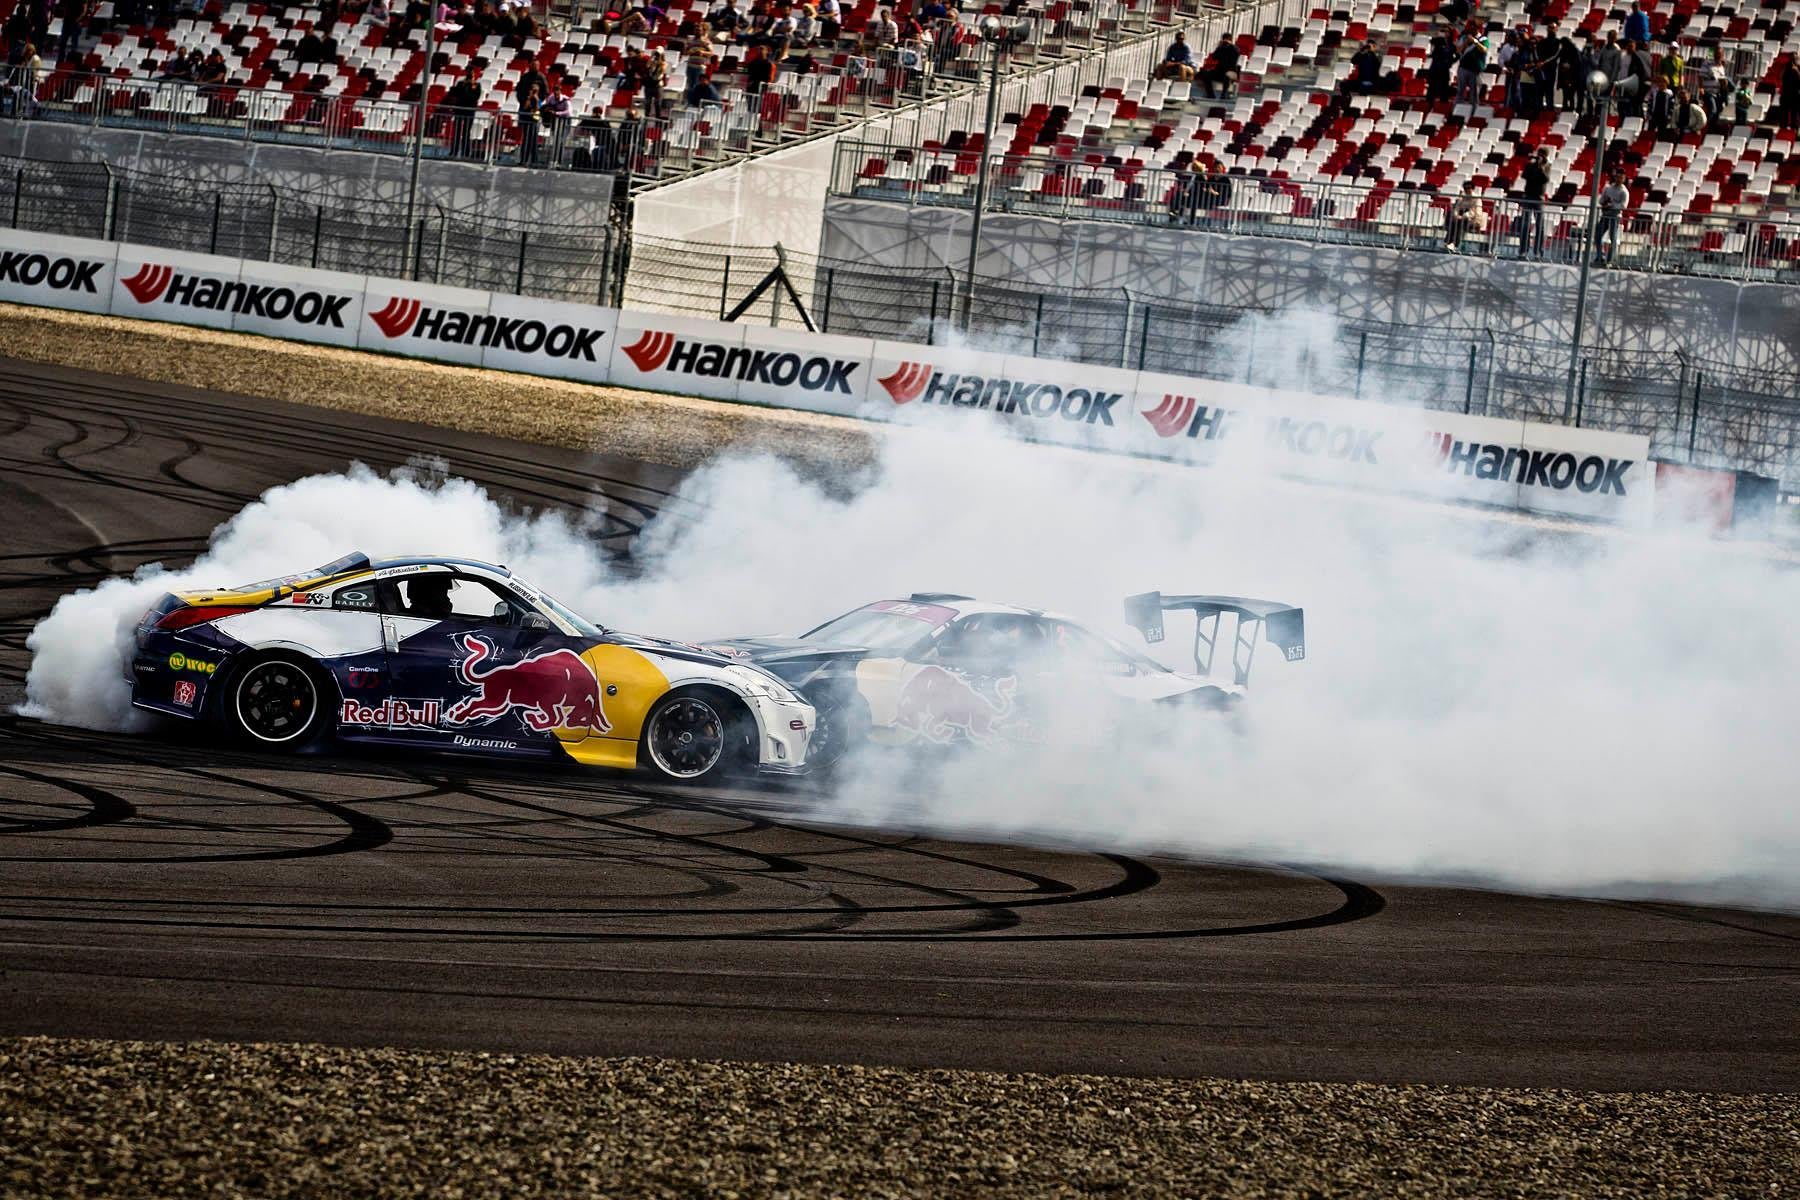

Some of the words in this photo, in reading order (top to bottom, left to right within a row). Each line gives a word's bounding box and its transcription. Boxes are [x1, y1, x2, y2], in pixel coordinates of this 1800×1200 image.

[0, 251, 104, 293] KOOK
[335, 600, 375, 608] OAKLEY
[342, 698, 390, 725] Red
[392, 700, 439, 726] Bull
[453, 734, 518, 749] Dynamic
